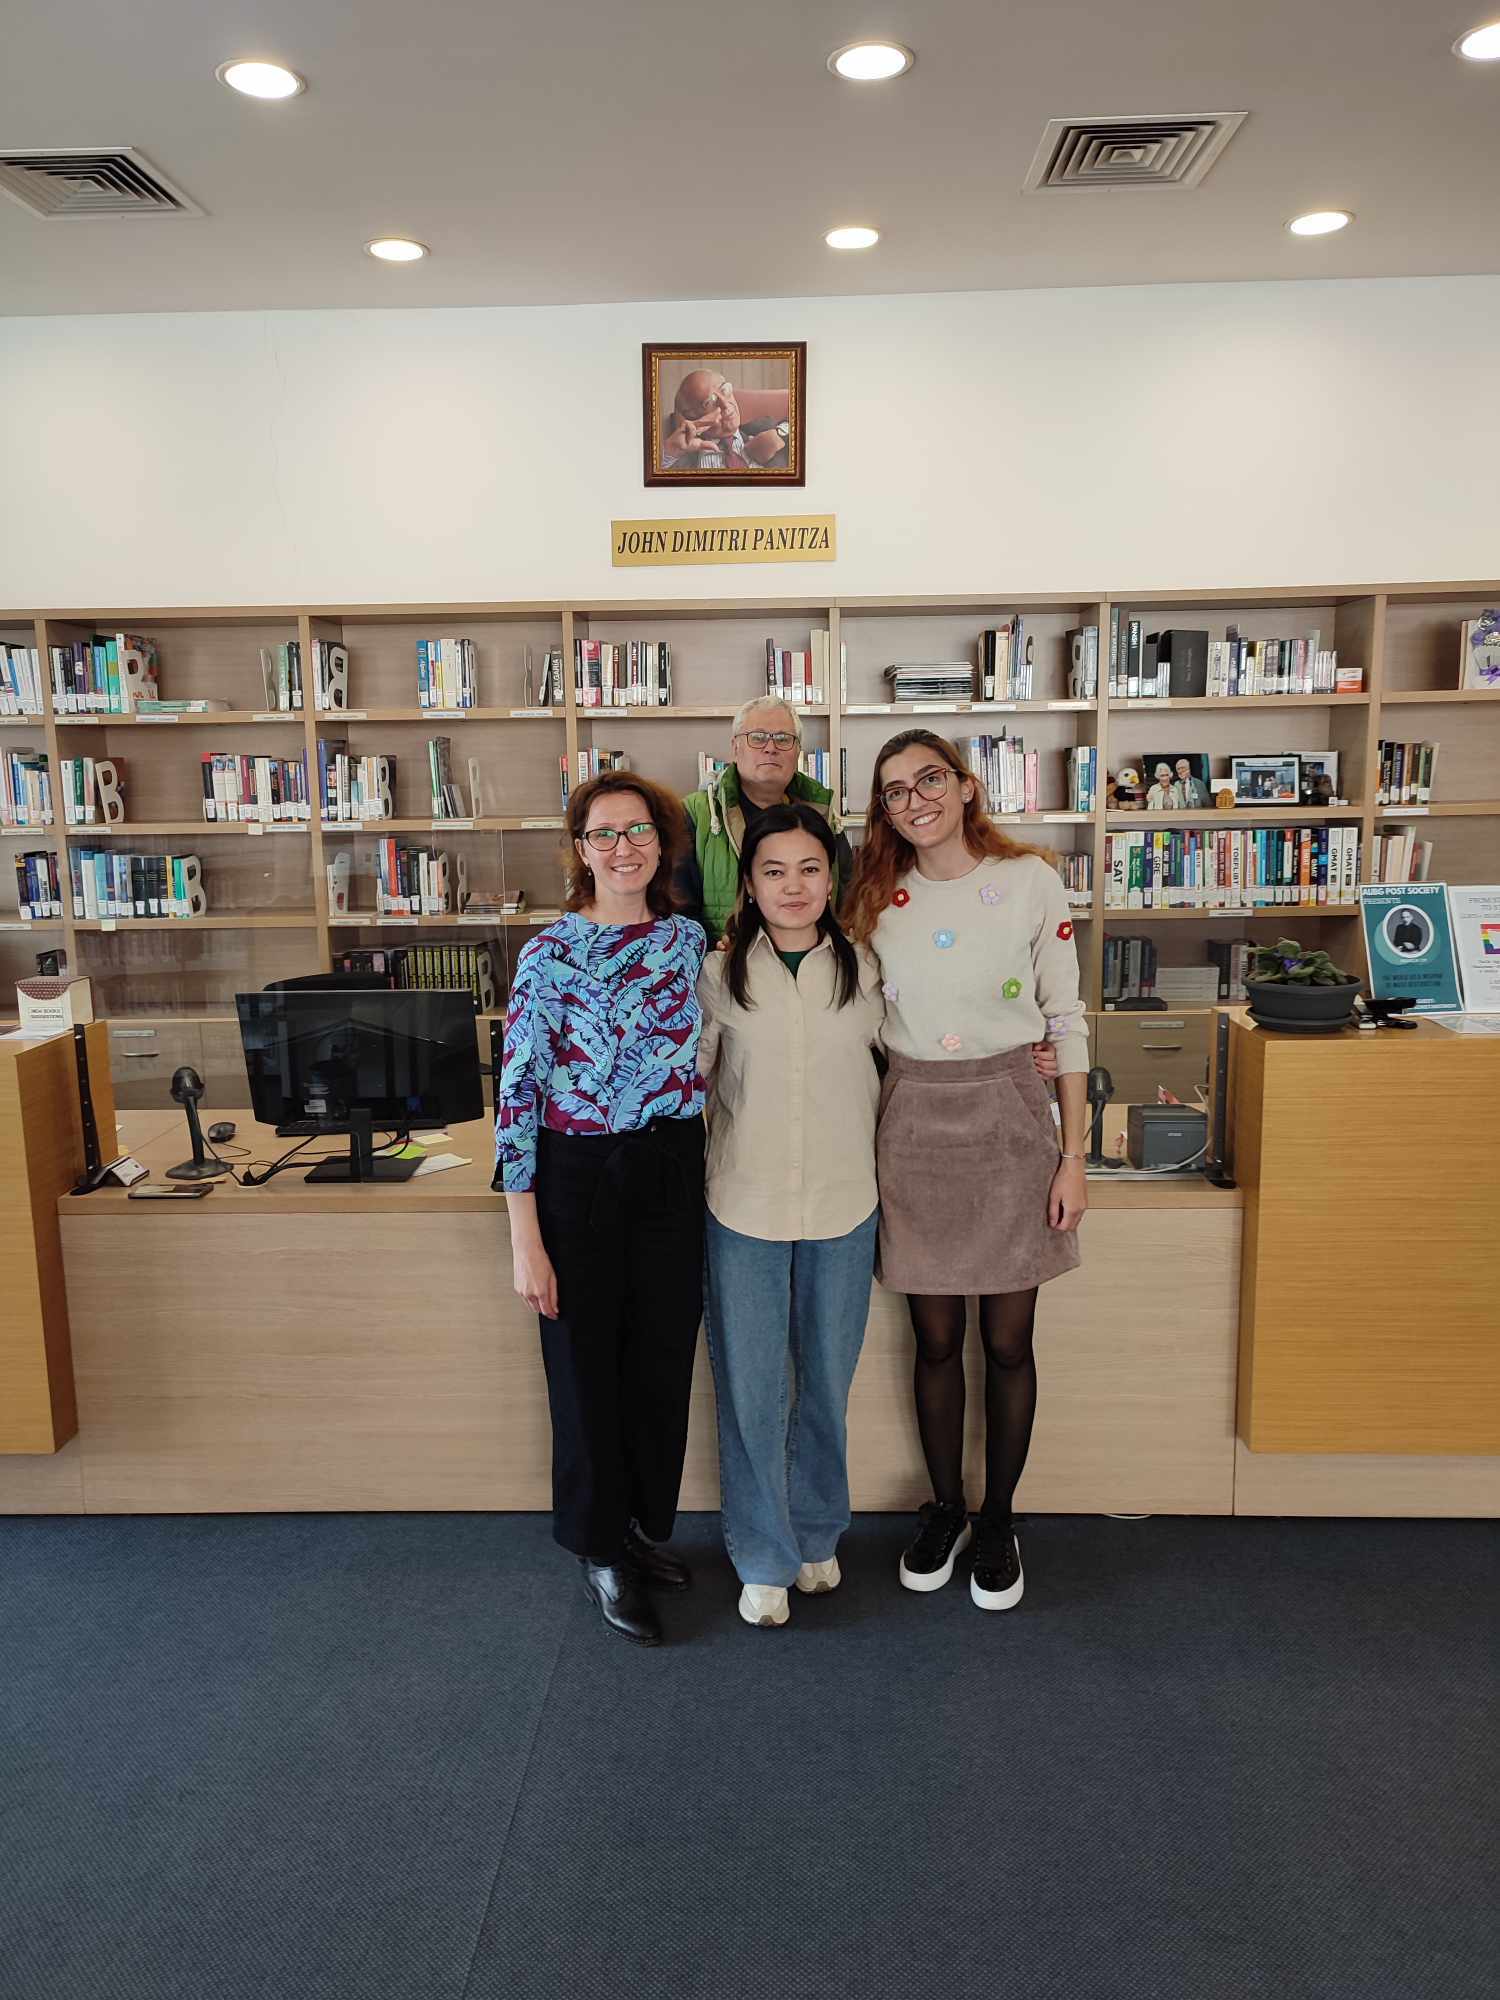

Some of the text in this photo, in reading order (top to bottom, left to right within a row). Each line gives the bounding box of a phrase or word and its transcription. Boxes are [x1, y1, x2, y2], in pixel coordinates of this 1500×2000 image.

[618, 527, 830, 554] JOHN DIMITRI PANITZA
[1330, 848, 1338, 871] GMAT
[1345, 847, 1353, 871] GMAT
[1113, 860, 1123, 884] SAT
[1385, 887, 1406, 895] POST
[1407, 886, 1440, 895] SOCIETY
